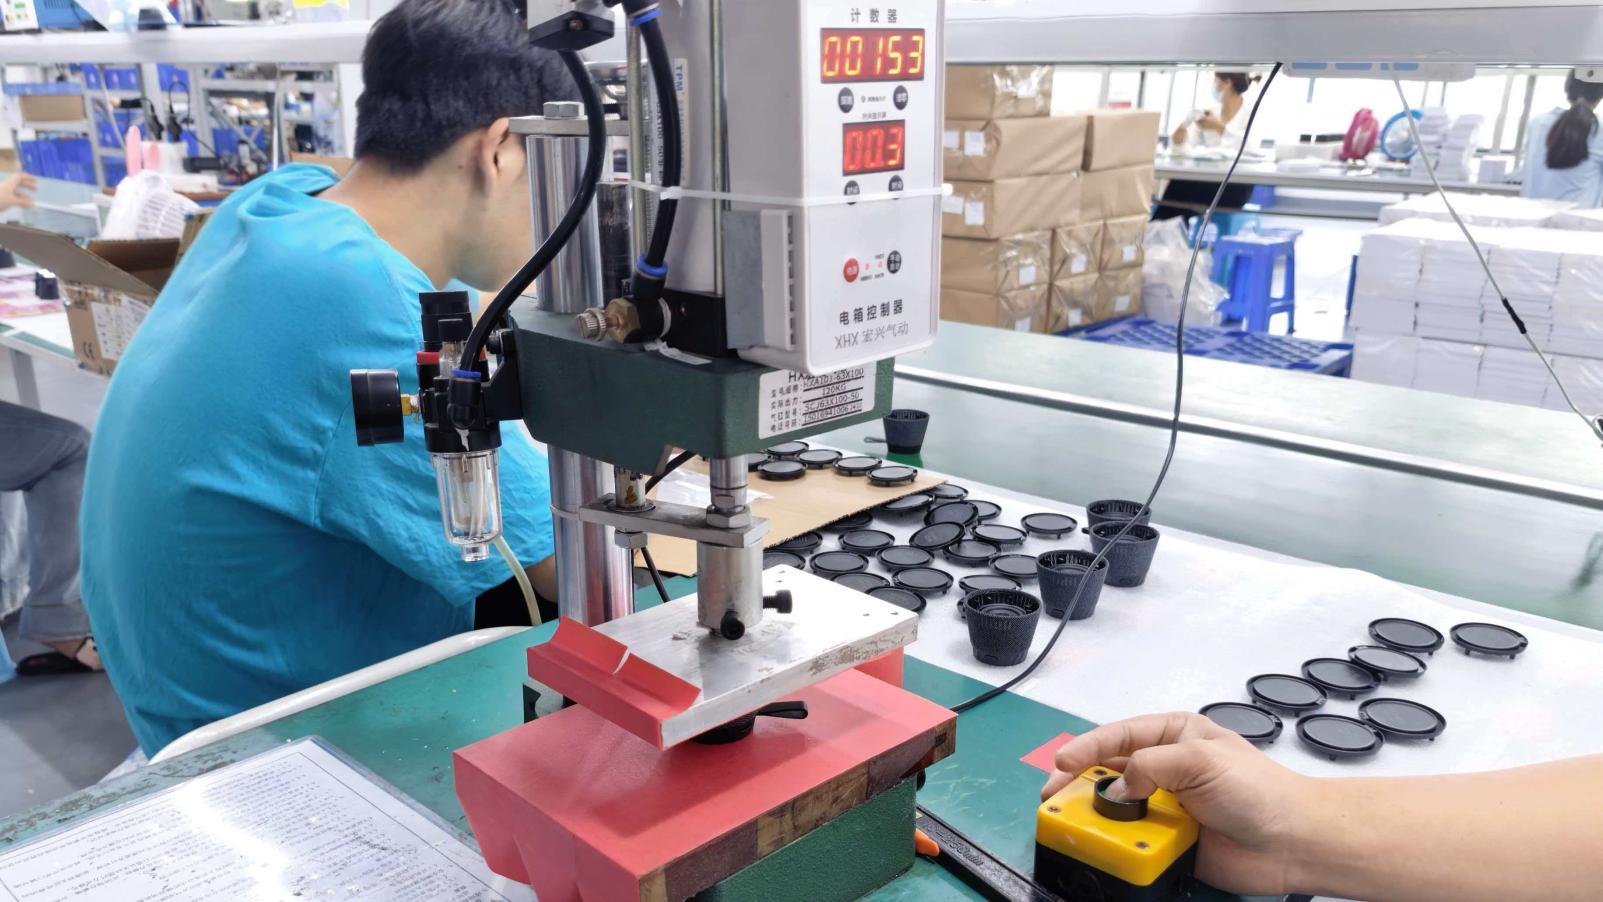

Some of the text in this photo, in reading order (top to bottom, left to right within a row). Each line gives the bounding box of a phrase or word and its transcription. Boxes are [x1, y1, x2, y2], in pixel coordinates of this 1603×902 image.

[850, 8, 897, 23] 计数器
[822, 35, 924, 77] 00153
[839, 298, 903, 326] 电箱控制器
[834, 321, 909, 350] XHX 宏兴气动
